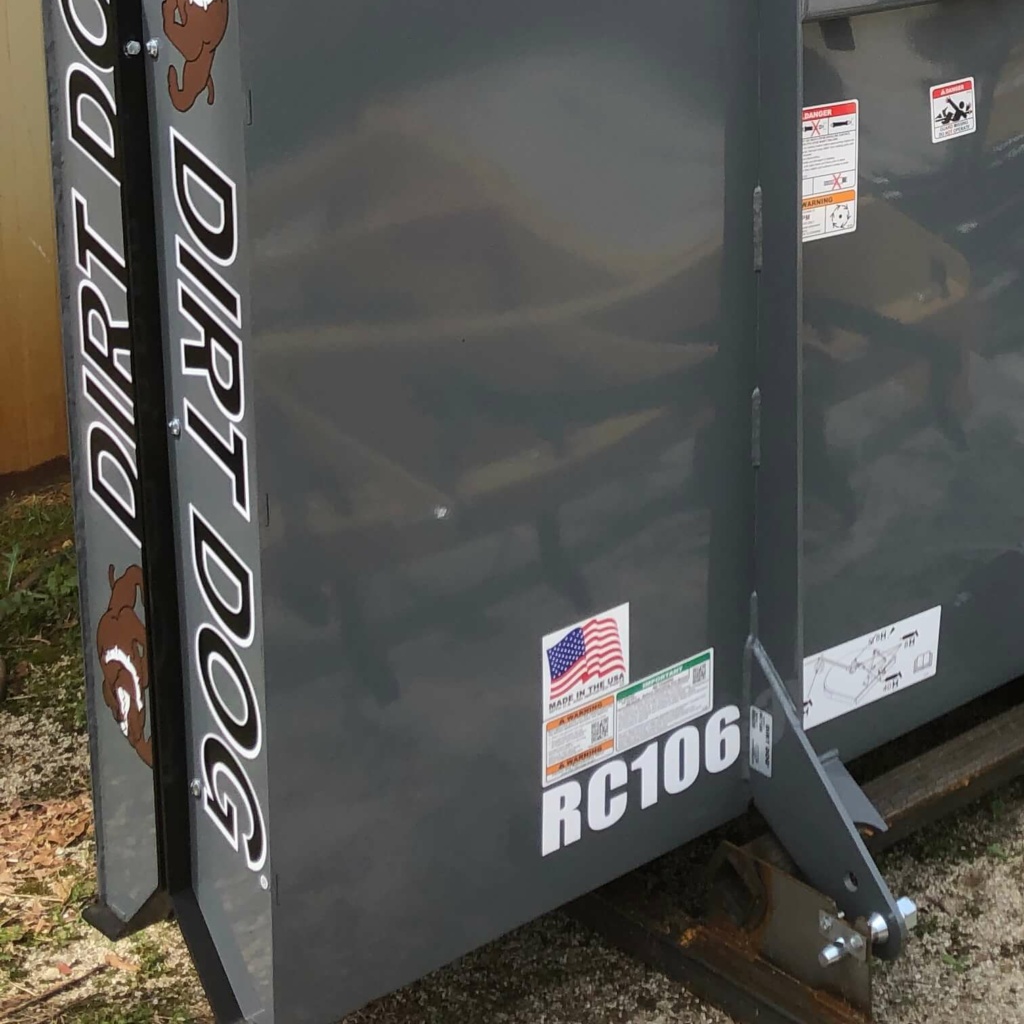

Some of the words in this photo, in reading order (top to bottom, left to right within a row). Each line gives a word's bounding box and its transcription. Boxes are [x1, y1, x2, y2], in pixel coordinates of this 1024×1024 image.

[804, 108, 833, 120] DANGER
[72, 186, 142, 549] DIRT
[169, 125, 250, 523] DIRT
[189, 502, 269, 871] DOG
[548, 694, 574, 711] MADE
[575, 690, 586, 700] IN
[588, 681, 605, 694] THE
[607, 672, 625, 687] USA
[566, 701, 603, 722] WARNING
[542, 705, 740, 857] RC106
[566, 744, 603, 765] WARNING
